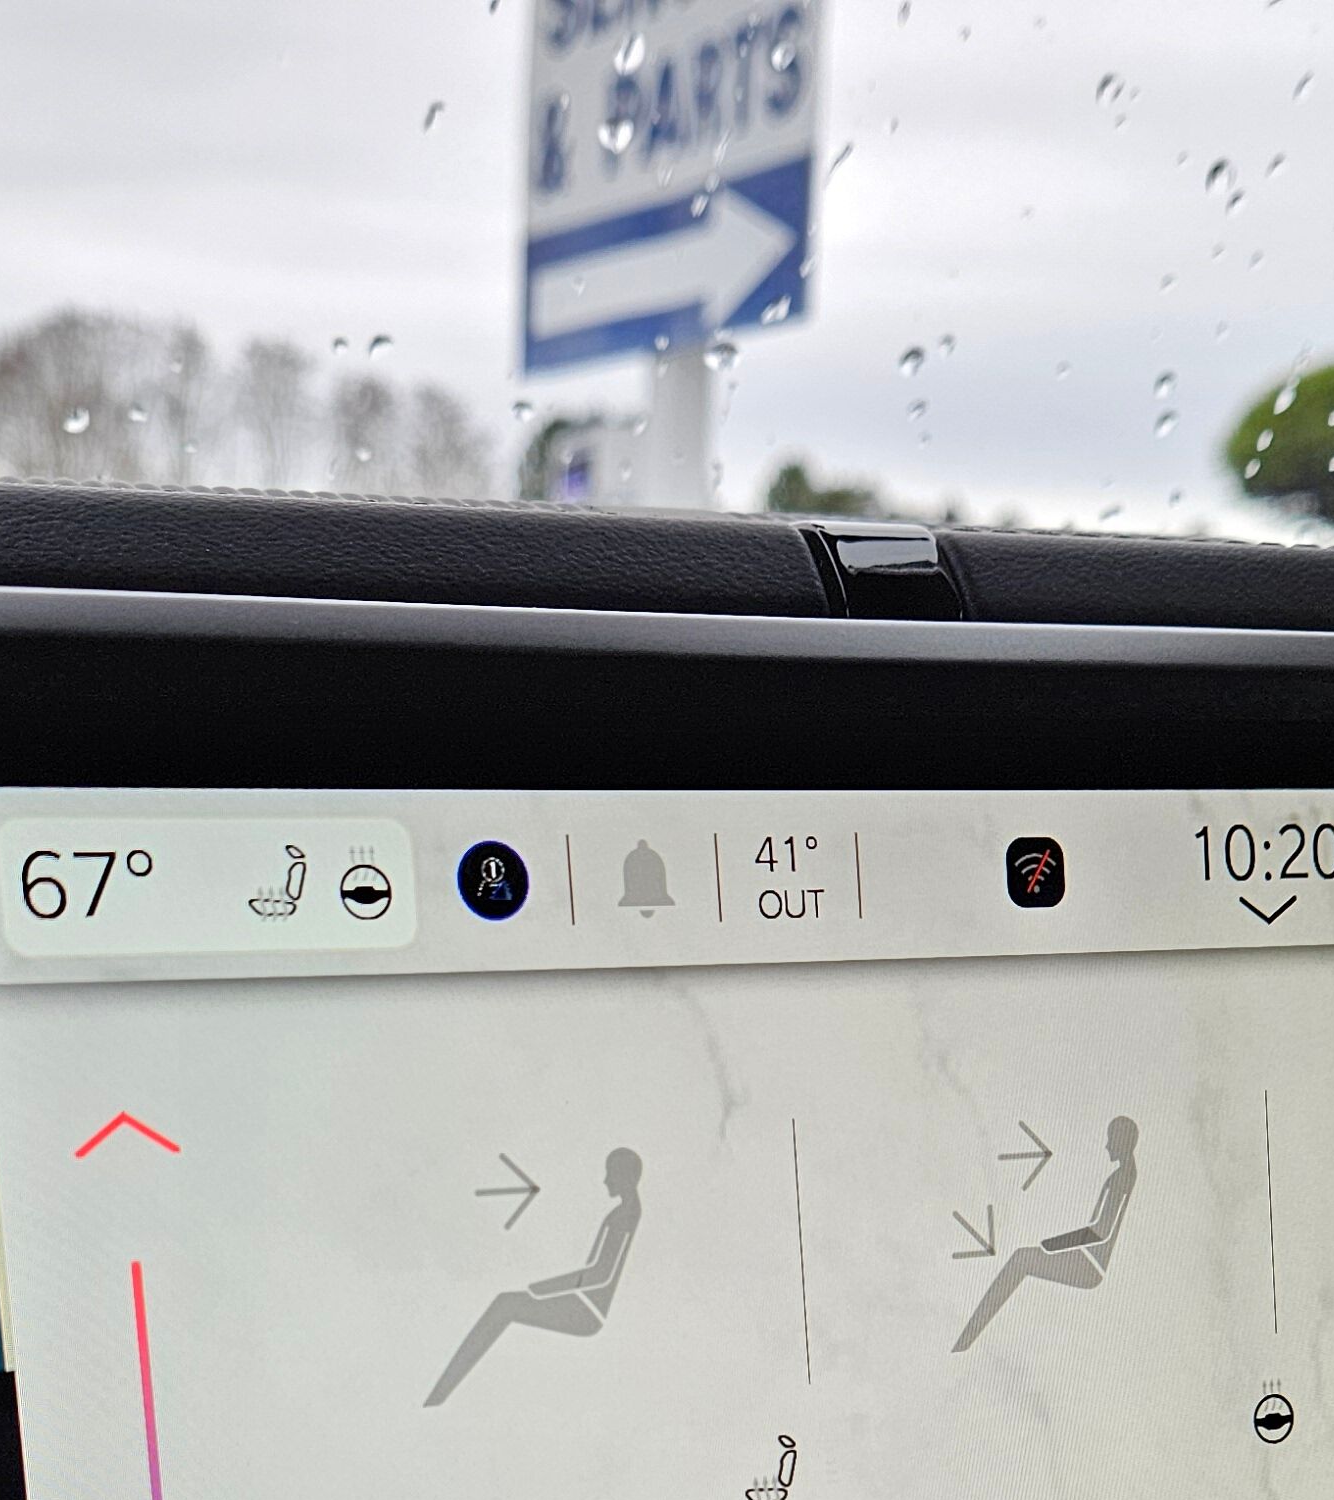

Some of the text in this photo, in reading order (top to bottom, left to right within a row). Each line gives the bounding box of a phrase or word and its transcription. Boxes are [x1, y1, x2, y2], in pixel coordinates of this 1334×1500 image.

[601, 5, 805, 180] PARTS
[754, 835, 818, 873] 41°
[21, 849, 153, 920] 67°
[758, 888, 825, 920] OUT
